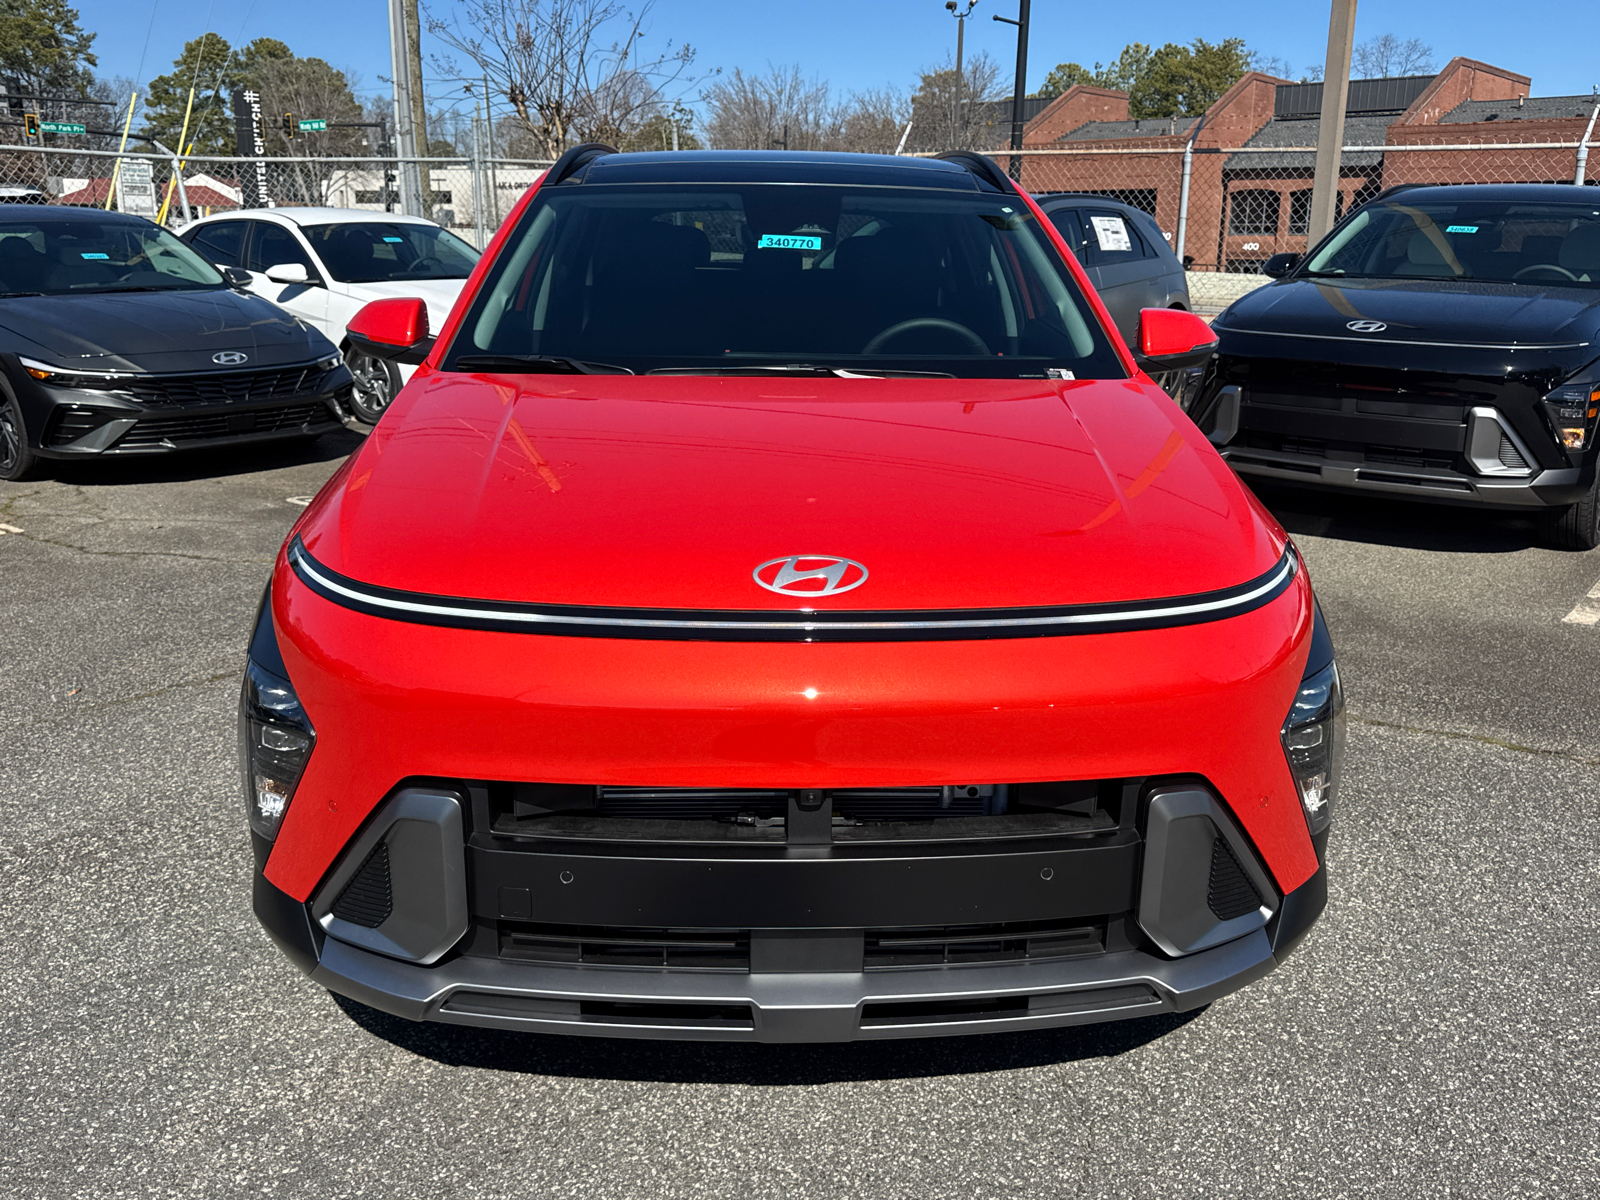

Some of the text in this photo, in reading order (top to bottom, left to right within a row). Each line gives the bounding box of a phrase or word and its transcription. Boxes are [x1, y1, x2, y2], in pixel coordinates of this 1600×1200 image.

[40, 123, 57, 131] North
[766, 237, 814, 249] 340770
[1242, 242, 1259, 251] 400
